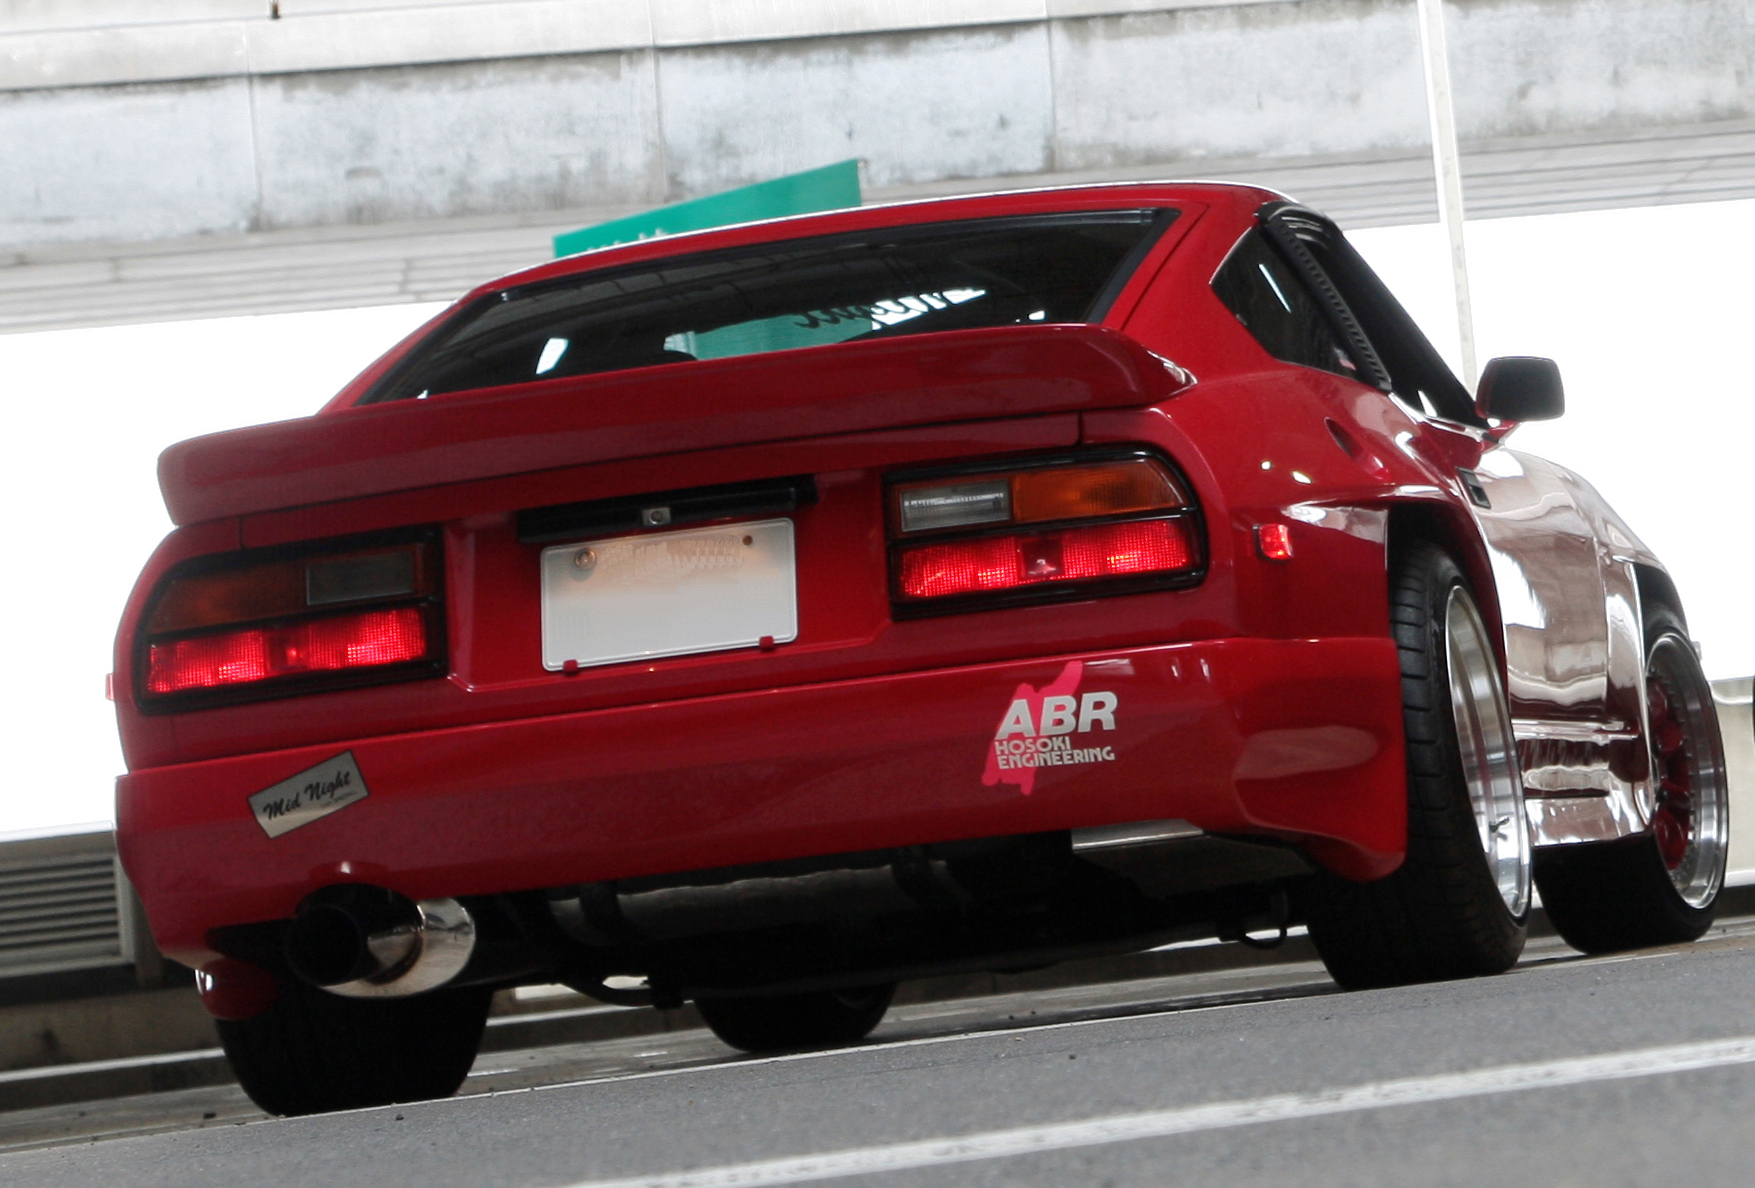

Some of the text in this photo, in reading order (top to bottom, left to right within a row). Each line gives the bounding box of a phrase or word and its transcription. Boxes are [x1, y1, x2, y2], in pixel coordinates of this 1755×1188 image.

[994, 691, 1118, 740] ABR
[995, 736, 1071, 755] HOSOKI
[997, 746, 1115, 770] ENGINEERING
[263, 793, 301, 820] Mid
[304, 771, 351, 801] Night
